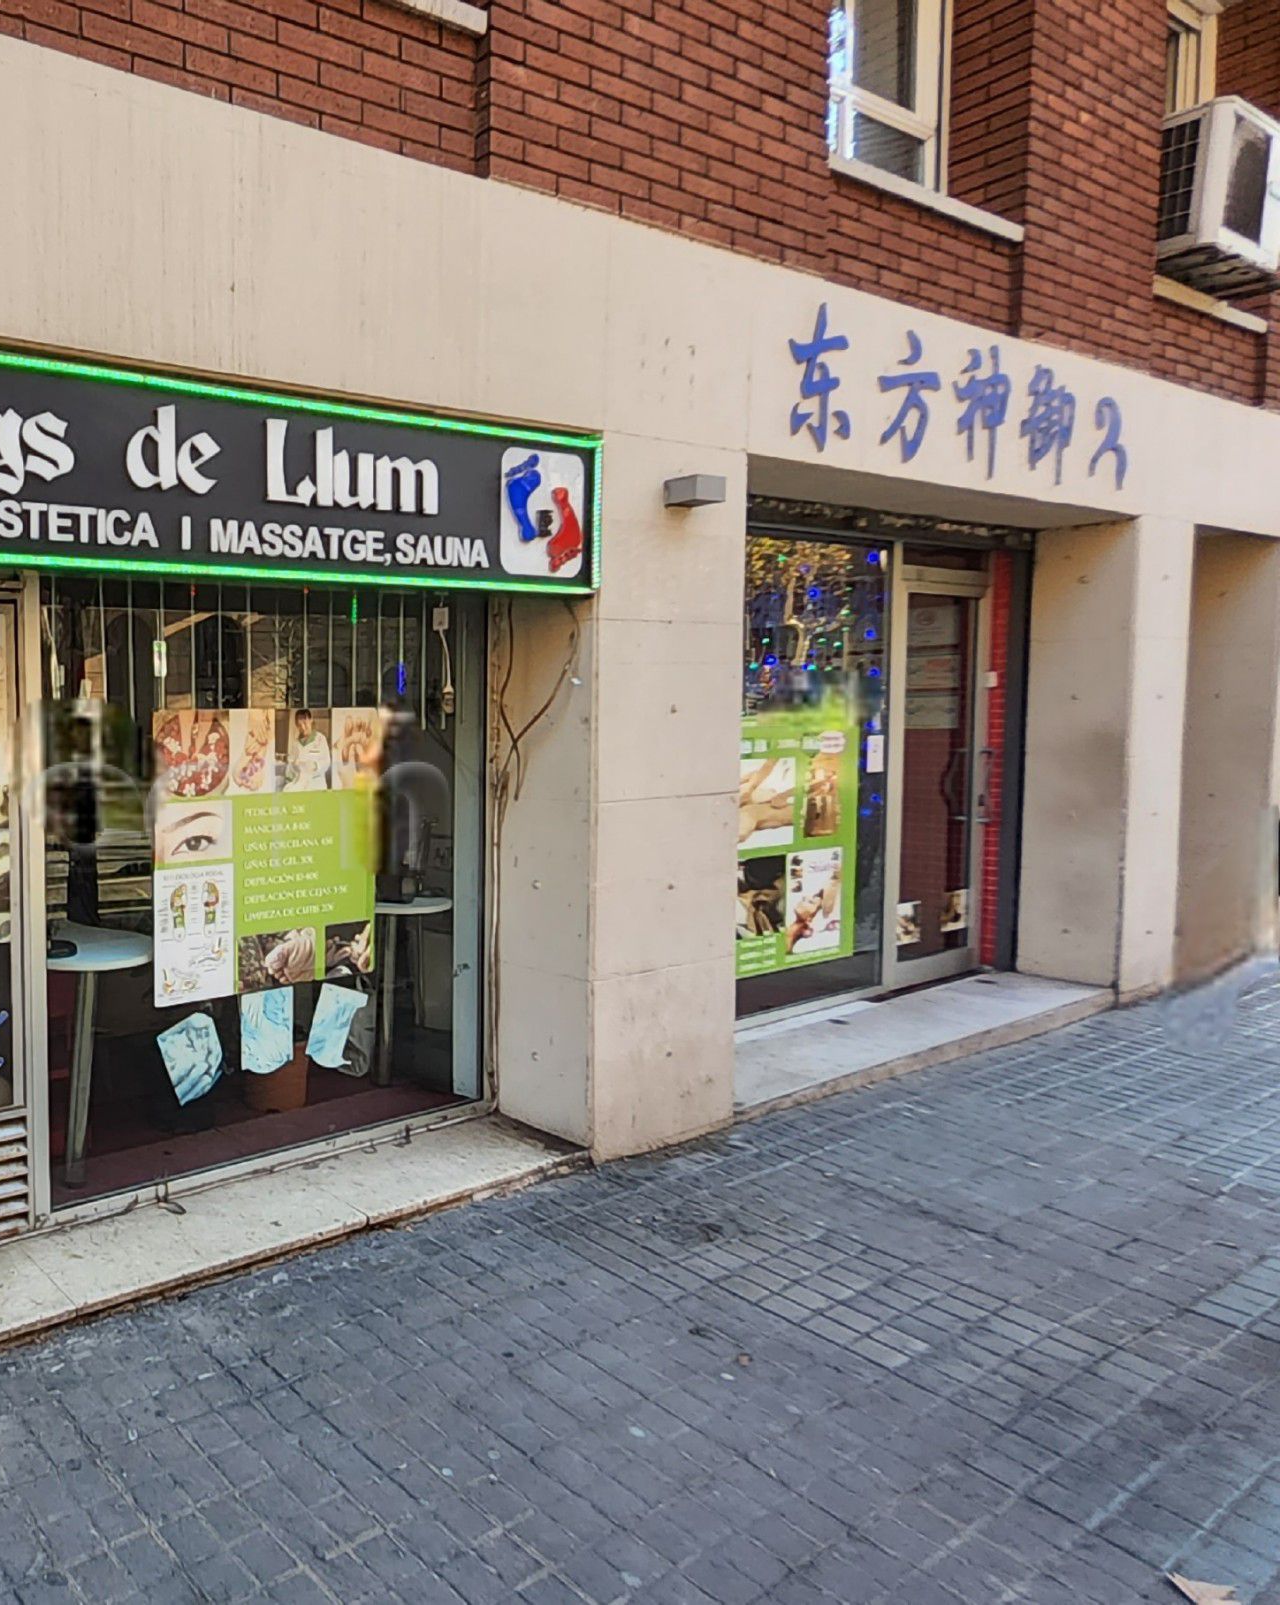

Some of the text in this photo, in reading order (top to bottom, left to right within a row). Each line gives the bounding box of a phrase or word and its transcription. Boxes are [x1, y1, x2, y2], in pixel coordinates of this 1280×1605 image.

[126, 404, 221, 495] de
[265, 418, 440, 516] Llum
[181, 516, 192, 551] I
[395, 532, 490, 569] SAUNA
